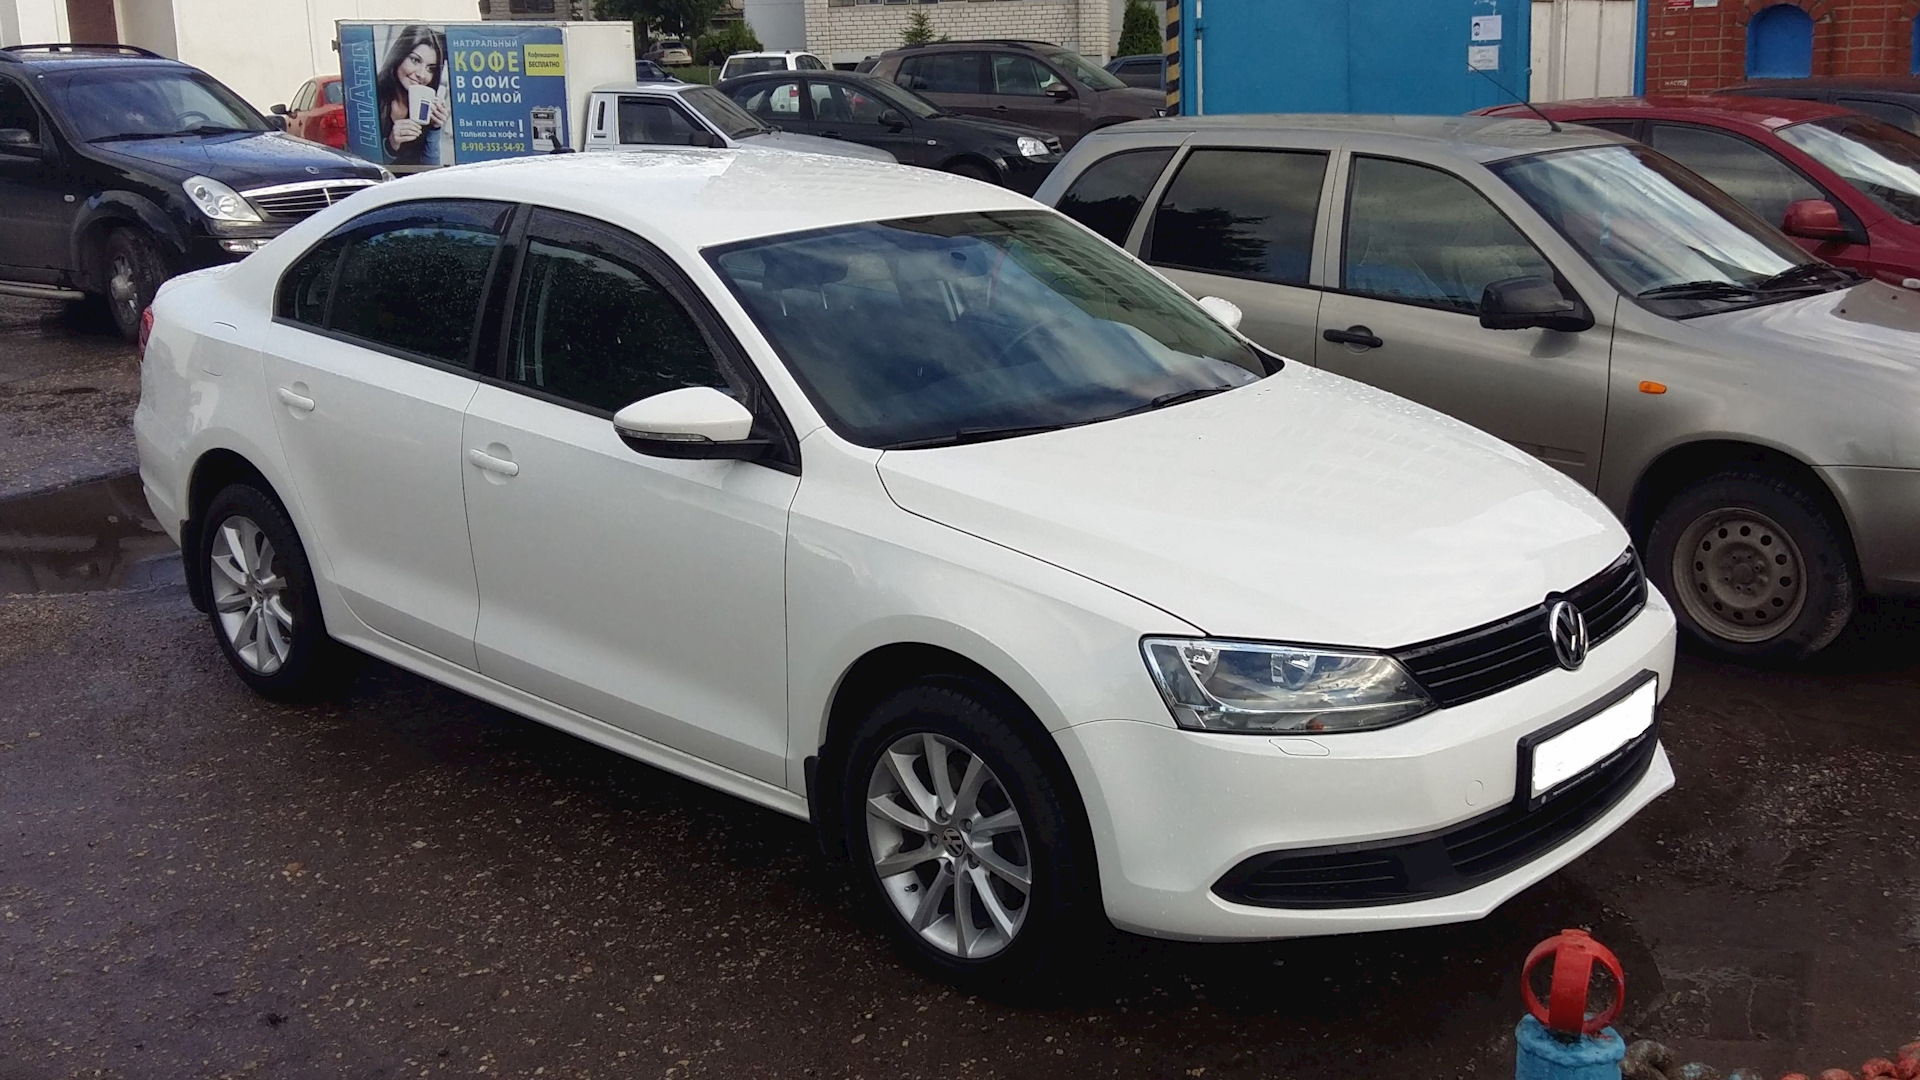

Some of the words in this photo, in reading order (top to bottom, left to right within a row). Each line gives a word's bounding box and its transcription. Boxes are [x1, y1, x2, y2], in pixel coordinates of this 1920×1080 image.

[453, 39, 518, 47] НАТУРАЛЬНЫЙ
[454, 50, 519, 72] КОФЕ
[456, 76, 465, 89] В
[471, 75, 521, 89] ОФИС
[457, 92, 466, 103] И
[470, 91, 522, 105] ДОМОЙ
[459, 118, 473, 127] Вы
[476, 119, 515, 127] платите
[498, 130, 517, 139] кофе
[461, 142, 525, 152] 8-910-353-54-92
